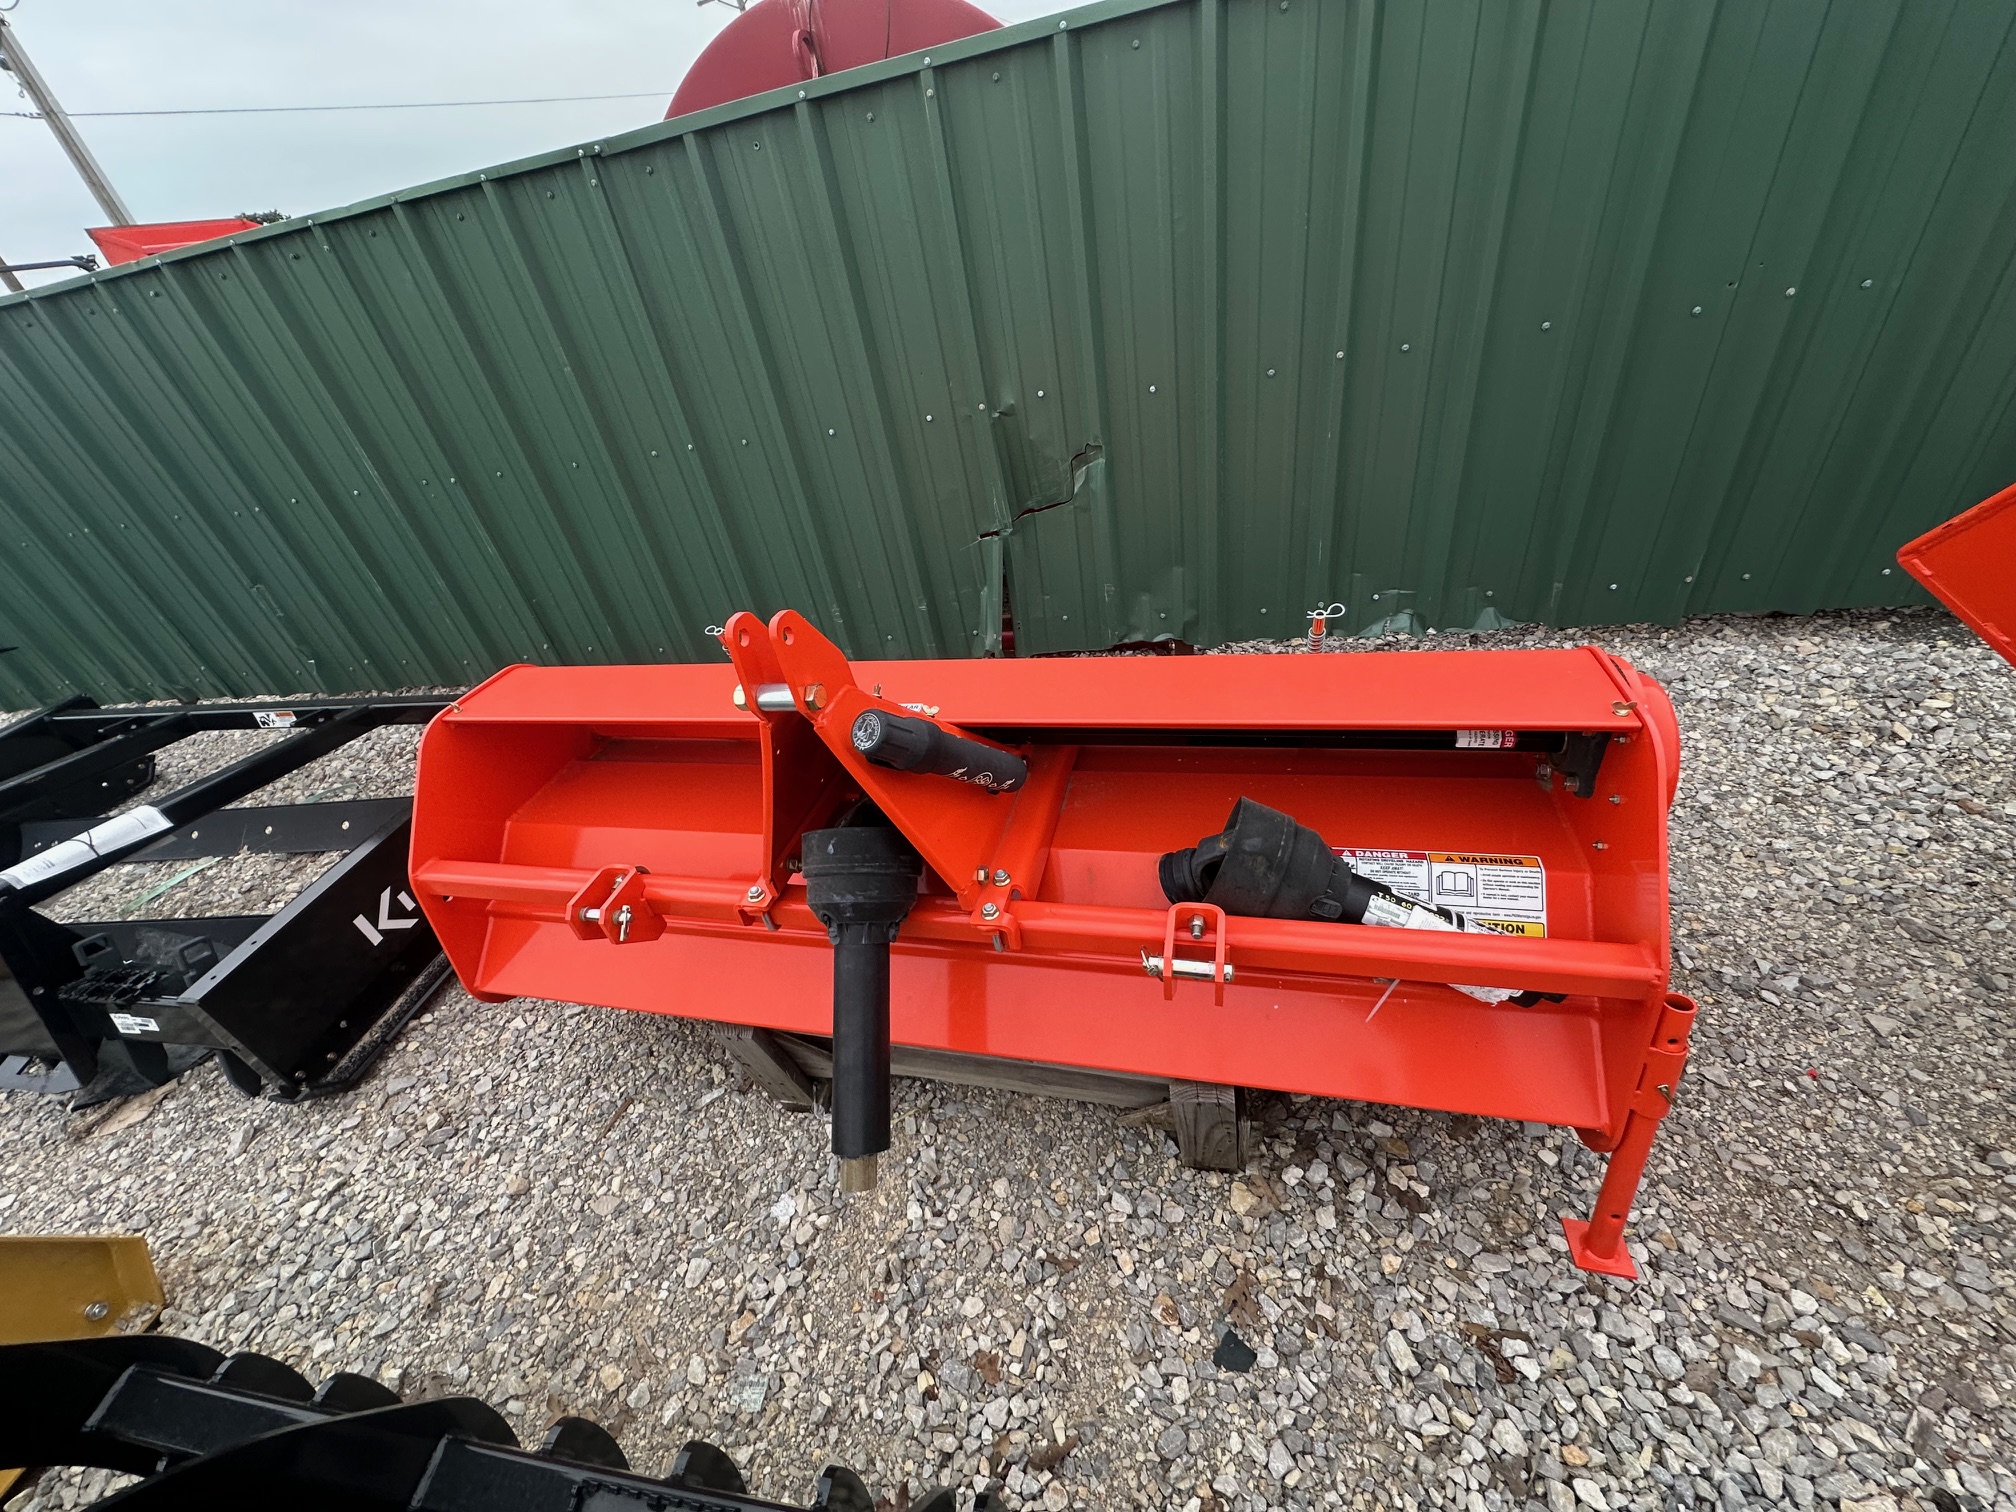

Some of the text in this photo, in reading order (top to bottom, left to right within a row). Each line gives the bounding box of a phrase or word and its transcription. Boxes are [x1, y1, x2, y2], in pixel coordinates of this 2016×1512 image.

[1503, 730, 1515, 748] GER
[1355, 850, 1409, 859] DANGER
[1458, 856, 1524, 865] WARNING
